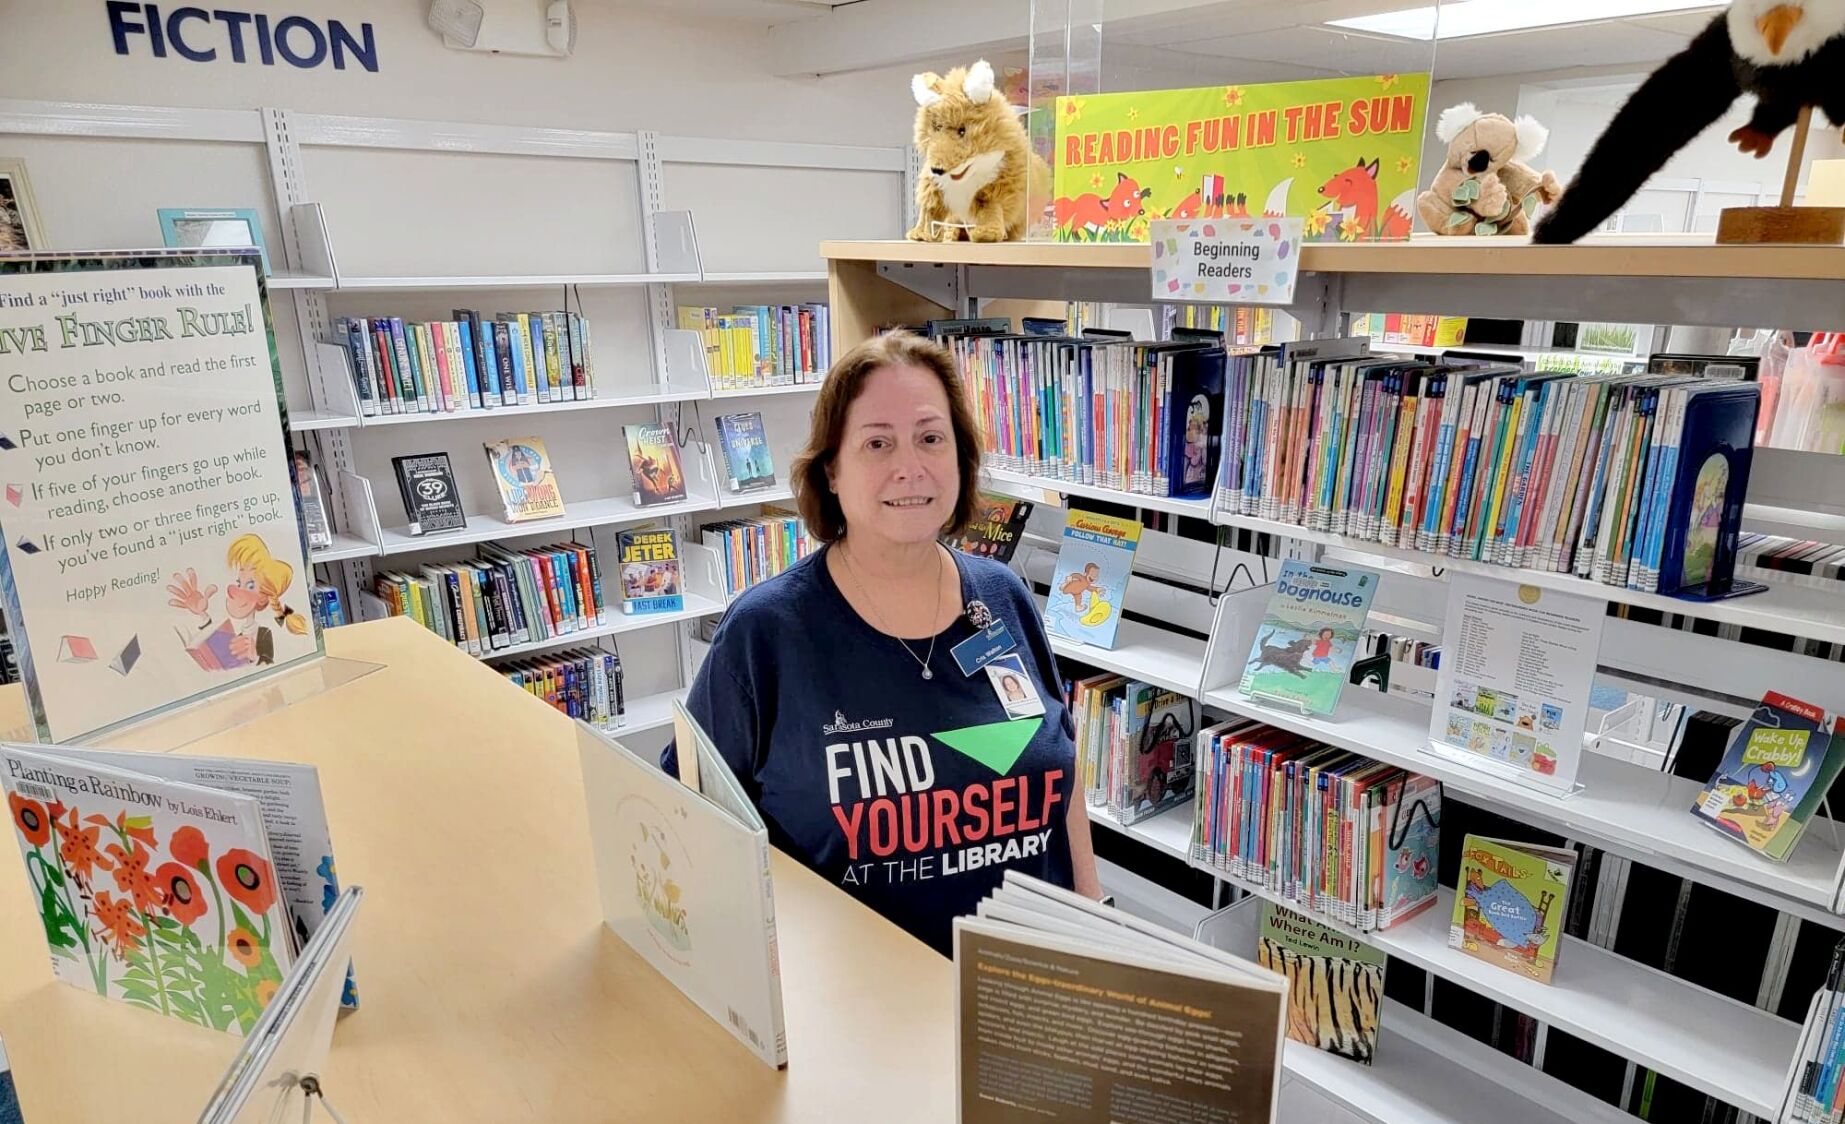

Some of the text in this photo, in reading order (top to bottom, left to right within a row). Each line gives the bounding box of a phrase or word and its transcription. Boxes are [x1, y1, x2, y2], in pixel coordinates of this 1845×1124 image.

[107, 0, 379, 73] FICTION
[1065, 94, 1414, 168] READING FUN IN THE SUN
[1193, 241, 1260, 267] Beginning
[1197, 262, 1252, 279] Readers
[0, 293, 34, 308] Find
[38, 295, 47, 306] a
[139, 285, 171, 300] book
[175, 283, 203, 299] with
[206, 283, 226, 297] the
[0, 303, 255, 356] IVE FINGER RULE!
[8, 354, 257, 393] Choose a book and read the first
[20, 400, 262, 448] Put one finger up for every word
[24, 392, 126, 420] page or two.
[35, 436, 161, 473] you don't know.
[31, 446, 267, 501] If five of your fingers go up while
[422, 482, 443, 496] 39
[47, 466, 263, 520] reading, choose another book.
[43, 490, 280, 551] If only two or three fingers go up,
[633, 533, 673, 544] DEREK
[982, 521, 1013, 542] Mice
[58, 548, 109, 574] you've
[112, 538, 155, 558] found
[159, 536, 168, 547] a
[248, 508, 284, 526] book.
[621, 541, 676, 562] JETER
[66, 568, 161, 603] Happy Reading!
[823, 717, 894, 733] Sarasota County
[1754, 731, 1786, 745] Wake
[825, 735, 935, 804] FIND
[1746, 746, 1802, 765] Crabby!
[7, 759, 238, 825] Planting a Rainbow by Lois Ehlert
[832, 769, 1064, 860] YOURSELF
[841, 829, 1052, 886] AT THE LIBRARY
[1490, 902, 1521, 915] Great
[1269, 915, 1316, 940] Where
[1319, 932, 1344, 948] Am
[1348, 940, 1361, 953] I?
[1285, 934, 1298, 945] Ted
